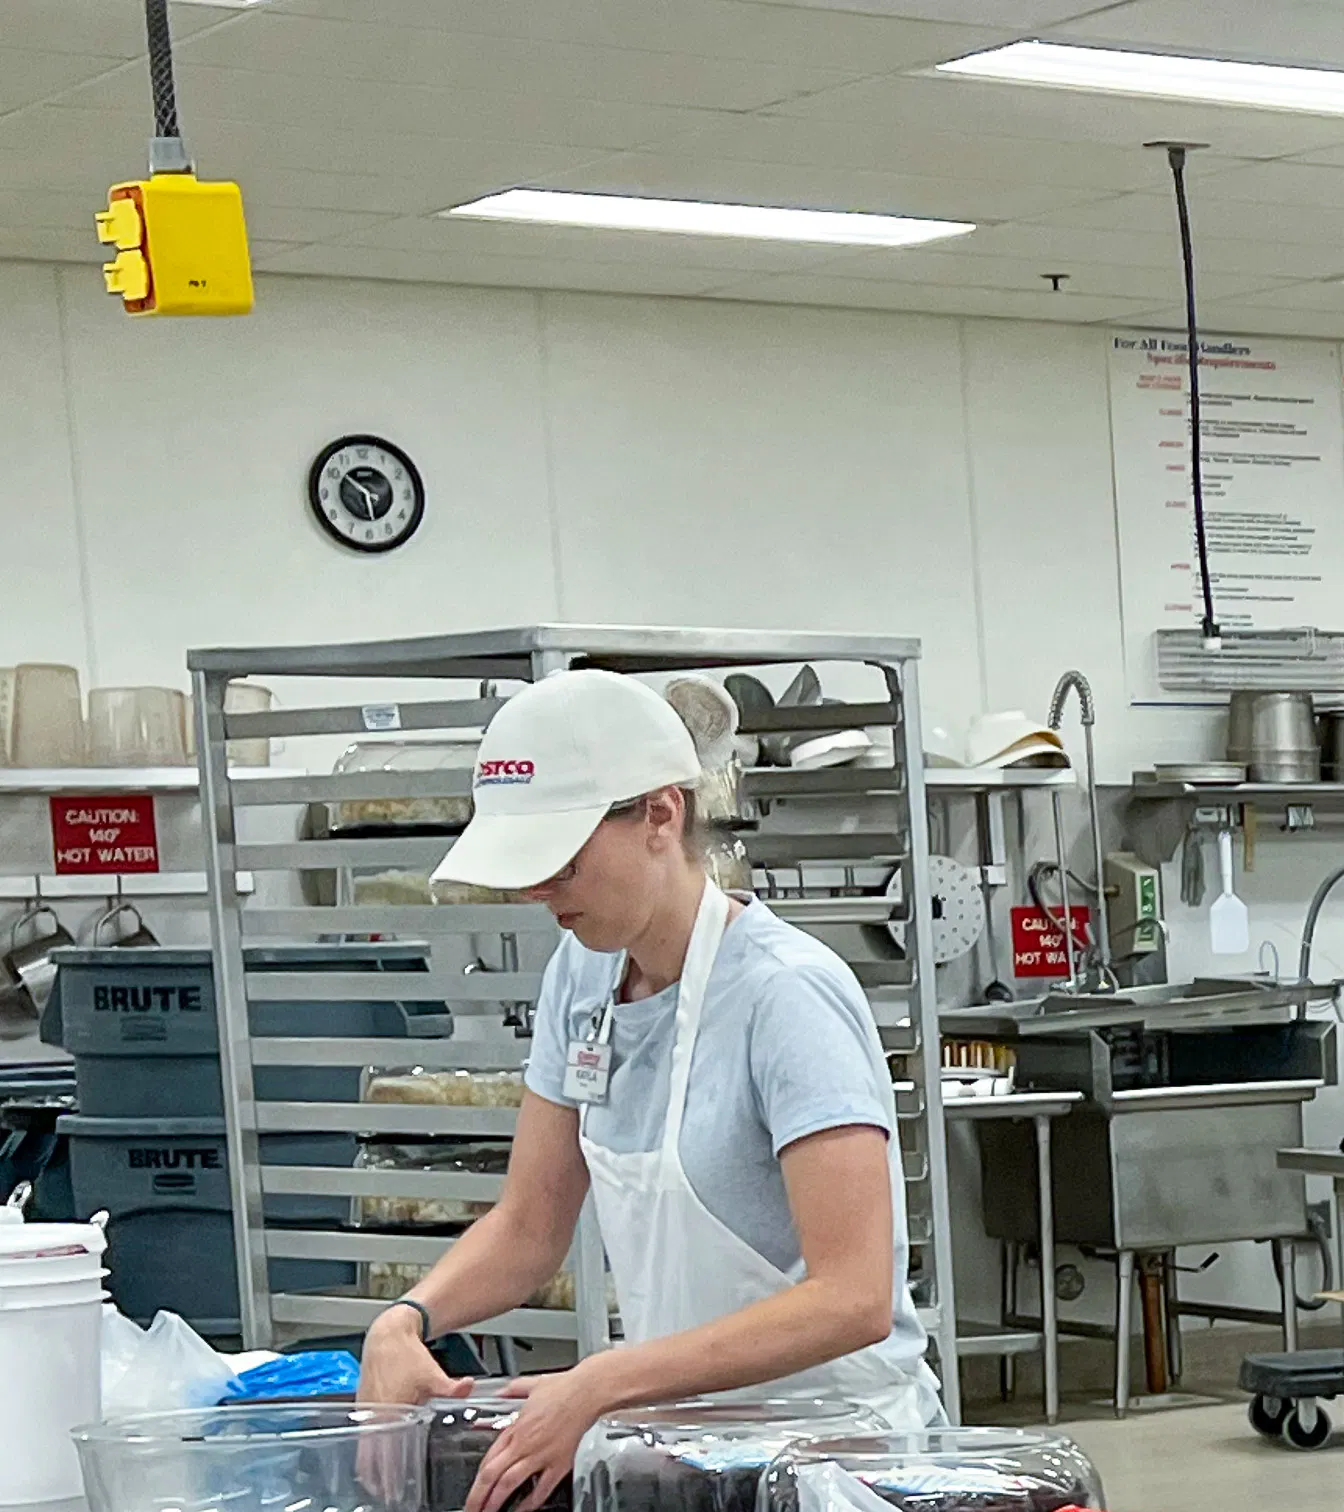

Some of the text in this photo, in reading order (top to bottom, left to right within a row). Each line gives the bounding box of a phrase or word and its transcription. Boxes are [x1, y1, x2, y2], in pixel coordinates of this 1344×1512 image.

[1139, 338, 1157, 350] All
[65, 809, 140, 825] CAUTION:
[57, 846, 155, 863] HOT WATER
[1015, 951, 1041, 965] HOT
[94, 986, 202, 1012] BRUTE
[128, 1149, 223, 1169] BRUTE
